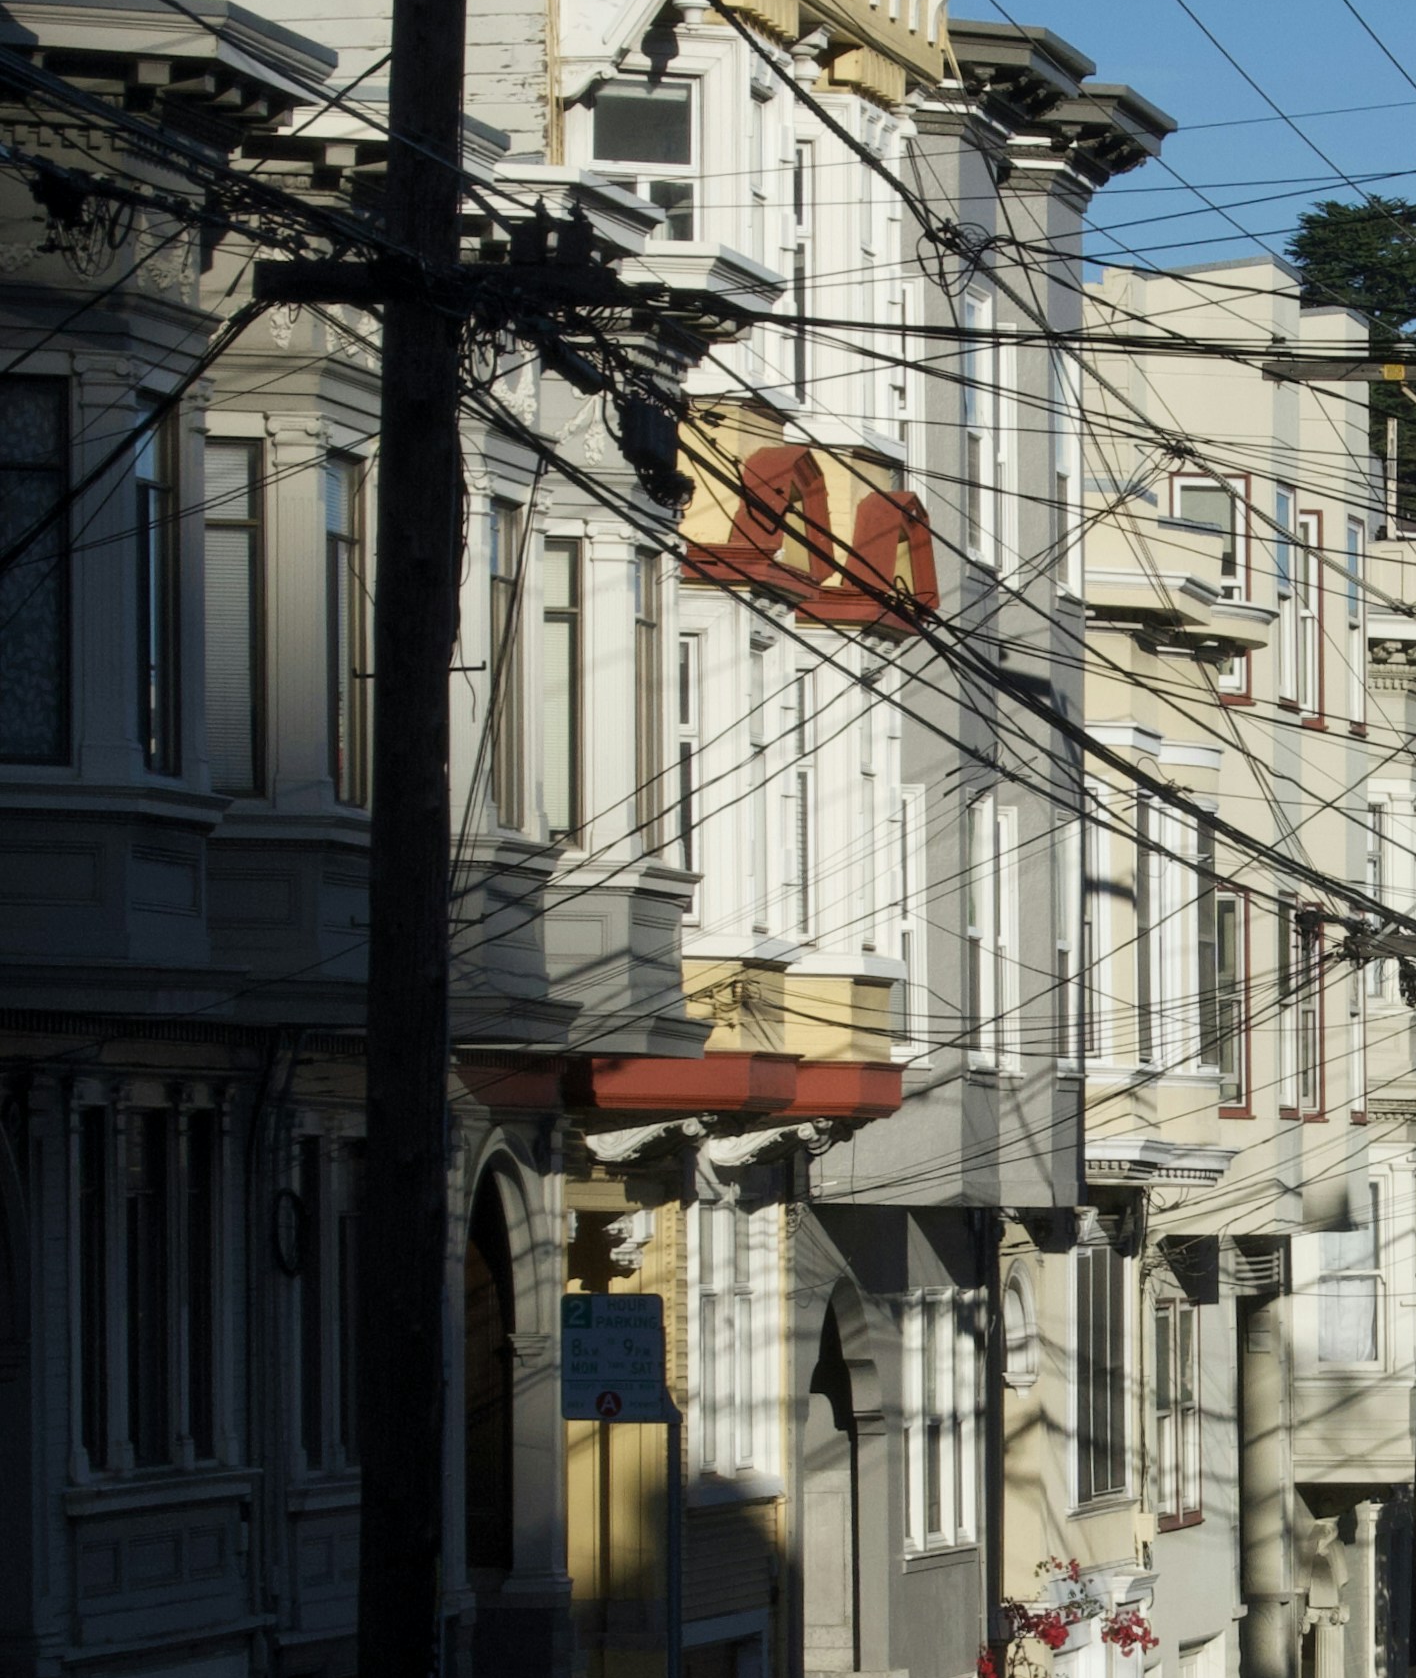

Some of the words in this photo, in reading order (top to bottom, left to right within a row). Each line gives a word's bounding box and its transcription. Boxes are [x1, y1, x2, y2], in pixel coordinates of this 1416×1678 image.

[568, 1299, 585, 1325] 2
[607, 1298, 647, 1311] HOUR
[595, 1315, 658, 1329] PARKING
[571, 1361, 598, 1374] MON
[630, 1361, 653, 1374] SAT
[600, 1392, 617, 1412] A
